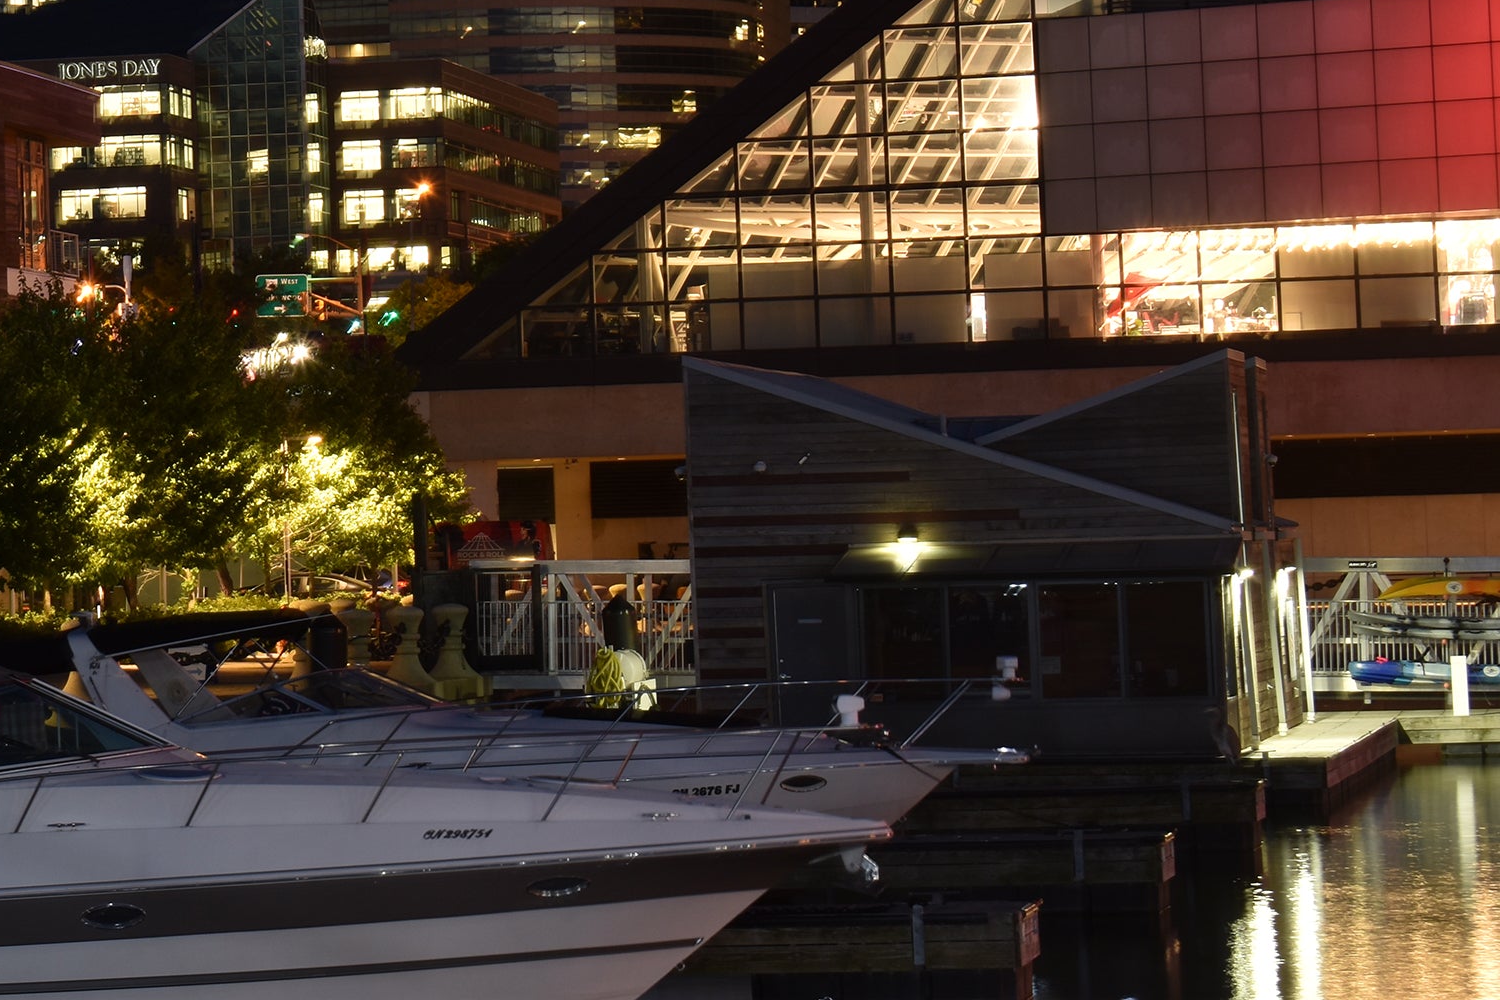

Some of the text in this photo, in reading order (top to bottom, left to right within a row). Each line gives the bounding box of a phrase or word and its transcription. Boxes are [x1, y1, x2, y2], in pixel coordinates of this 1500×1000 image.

[58, 59, 161, 80] JONES DAY
[725, 783, 741, 795] FJ
